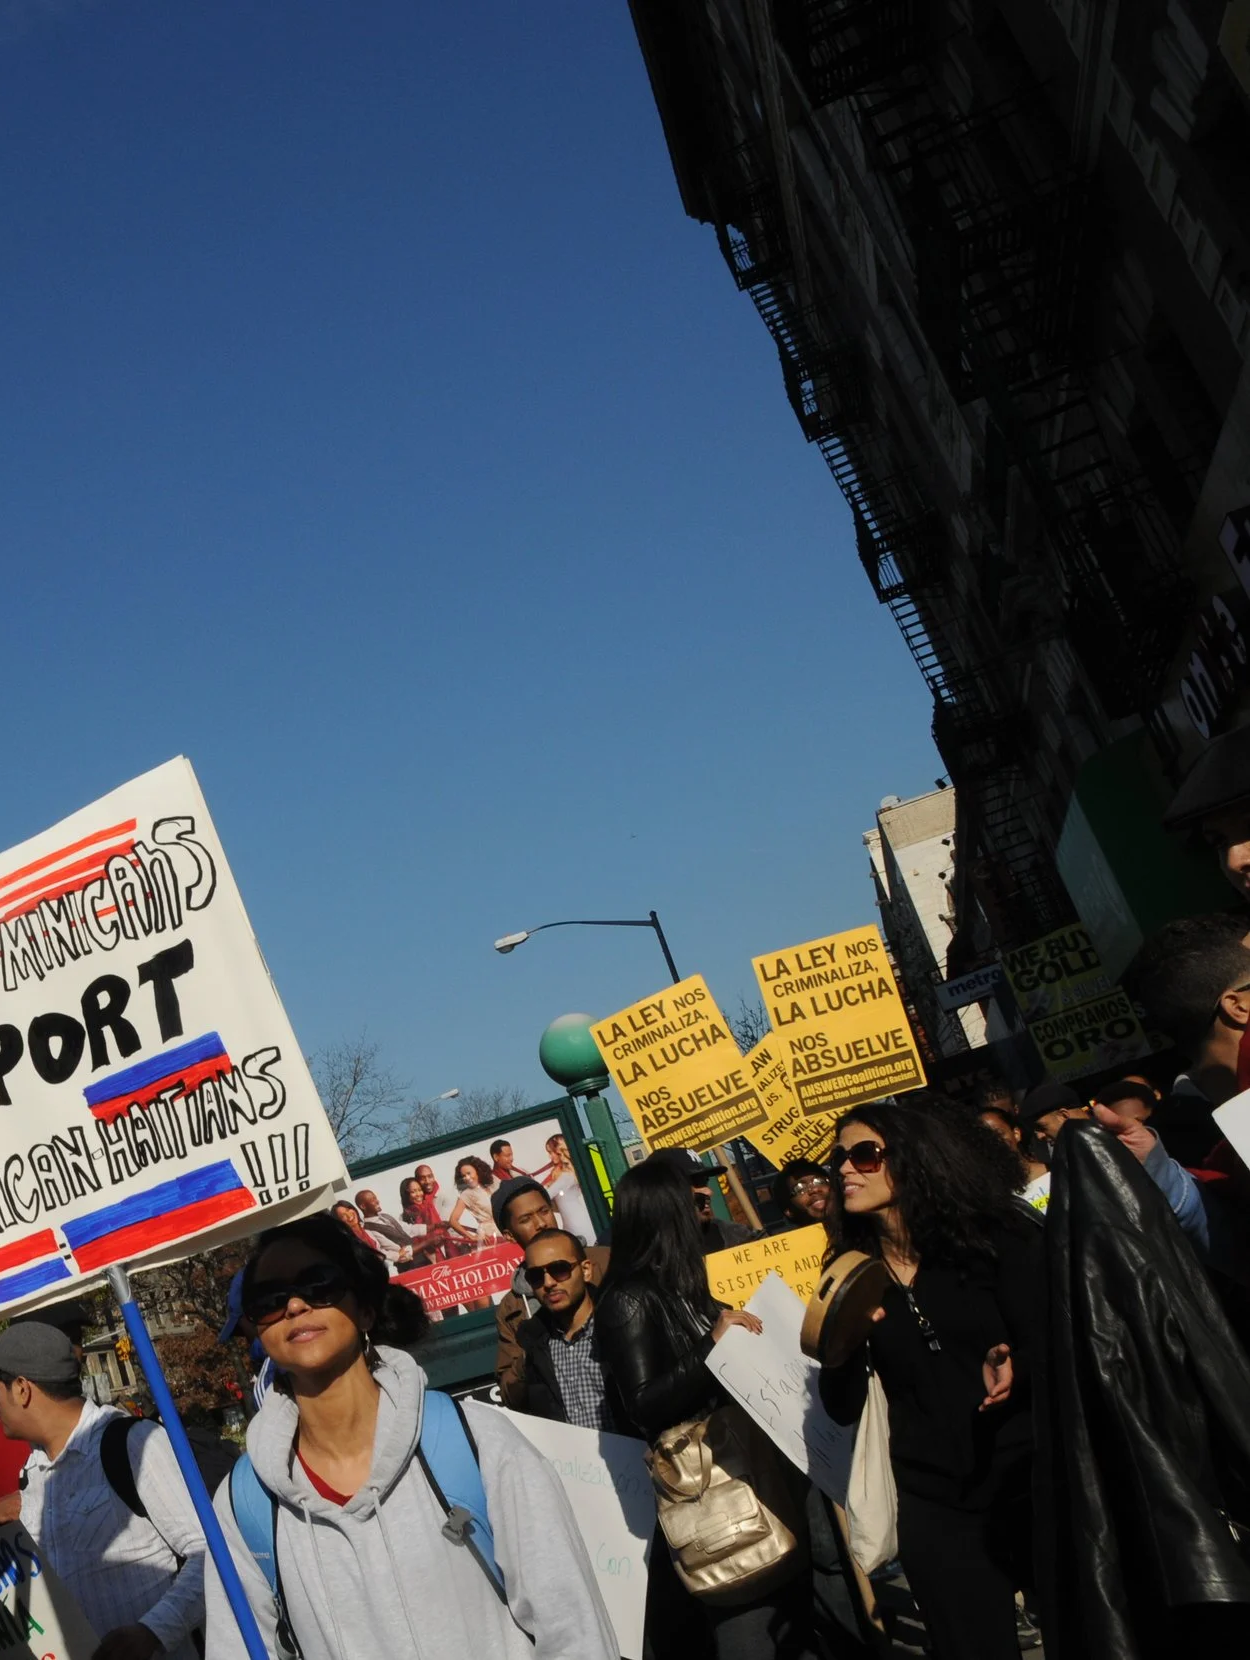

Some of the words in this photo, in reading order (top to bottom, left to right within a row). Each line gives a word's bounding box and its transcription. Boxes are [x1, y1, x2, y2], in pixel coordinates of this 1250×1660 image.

[760, 959, 791, 983] LA
[795, 942, 838, 971] LEY
[845, 938, 879, 958] NOS
[772, 960, 879, 998] CRIMINALIZA,
[1002, 945, 1041, 974] WE
[596, 1022, 625, 1048] LA
[626, 999, 667, 1037] LEY
[673, 987, 706, 1012] NOS
[773, 999, 808, 1027] LA
[811, 976, 894, 1018] LUCHA
[612, 1009, 709, 1061] CRIMINALIZA,
[615, 1061, 648, 1088] LA
[651, 1023, 727, 1075] LUCHA
[789, 1032, 828, 1055] NOS
[791, 1028, 908, 1079] ABSUELVE
[1043, 1017, 1137, 1061] ORO
[635, 1086, 671, 1112] NOS
[800, 1058, 914, 1099] ANSWERCoalition.org
[641, 1069, 749, 1134] ABSUELVE
[778, 1118, 830, 1167] ABSOLVE
[791, 1118, 814, 1138] WILL
[733, 1248, 753, 1265] WE
[763, 1238, 791, 1256] ARE
[794, 1254, 821, 1273] AND
[473, 1286, 484, 1297] 15
